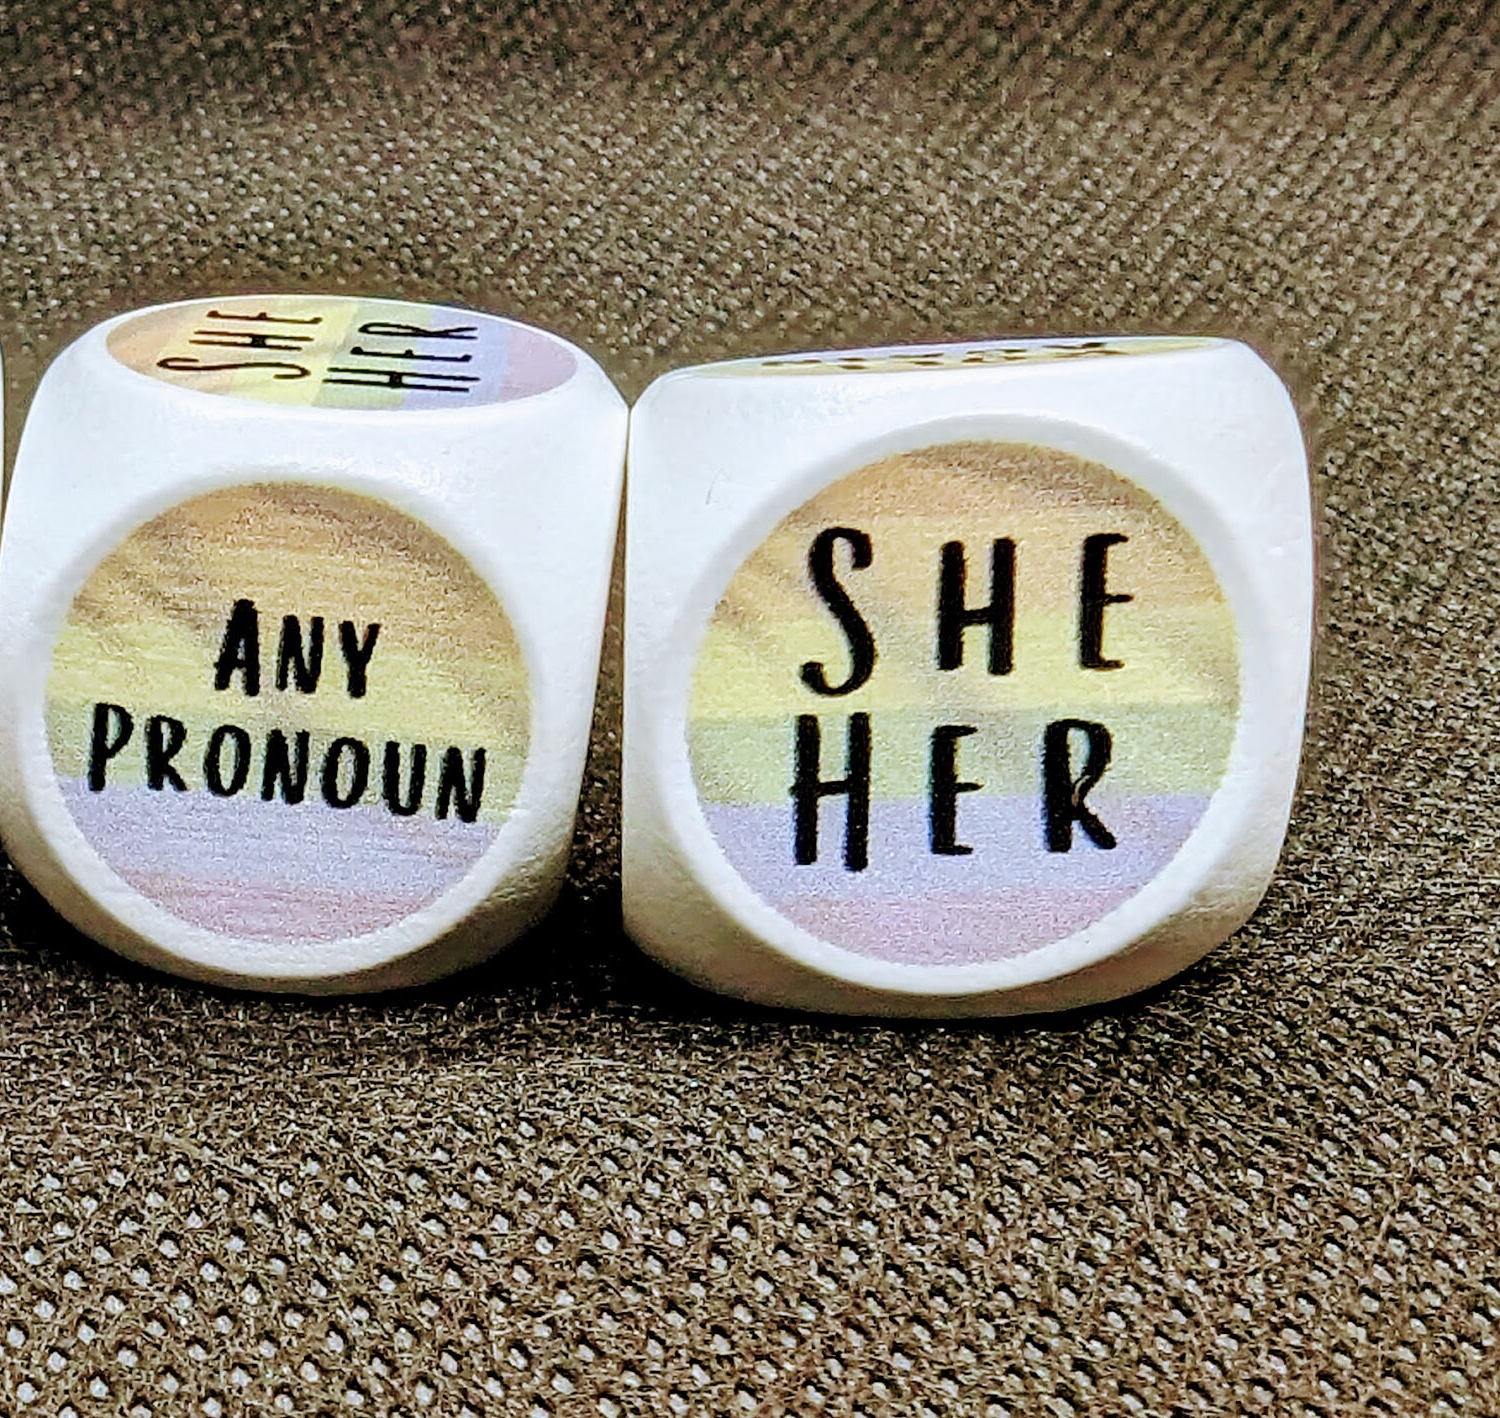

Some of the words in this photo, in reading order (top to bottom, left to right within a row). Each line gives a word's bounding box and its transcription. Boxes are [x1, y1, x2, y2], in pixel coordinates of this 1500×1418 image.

[155, 310, 322, 380] SHE
[322, 321, 480, 393] HER
[212, 597, 382, 699] ANY
[799, 525, 1134, 698] SHE
[86, 701, 488, 825] PRONOUN
[788, 710, 1118, 874] HER
